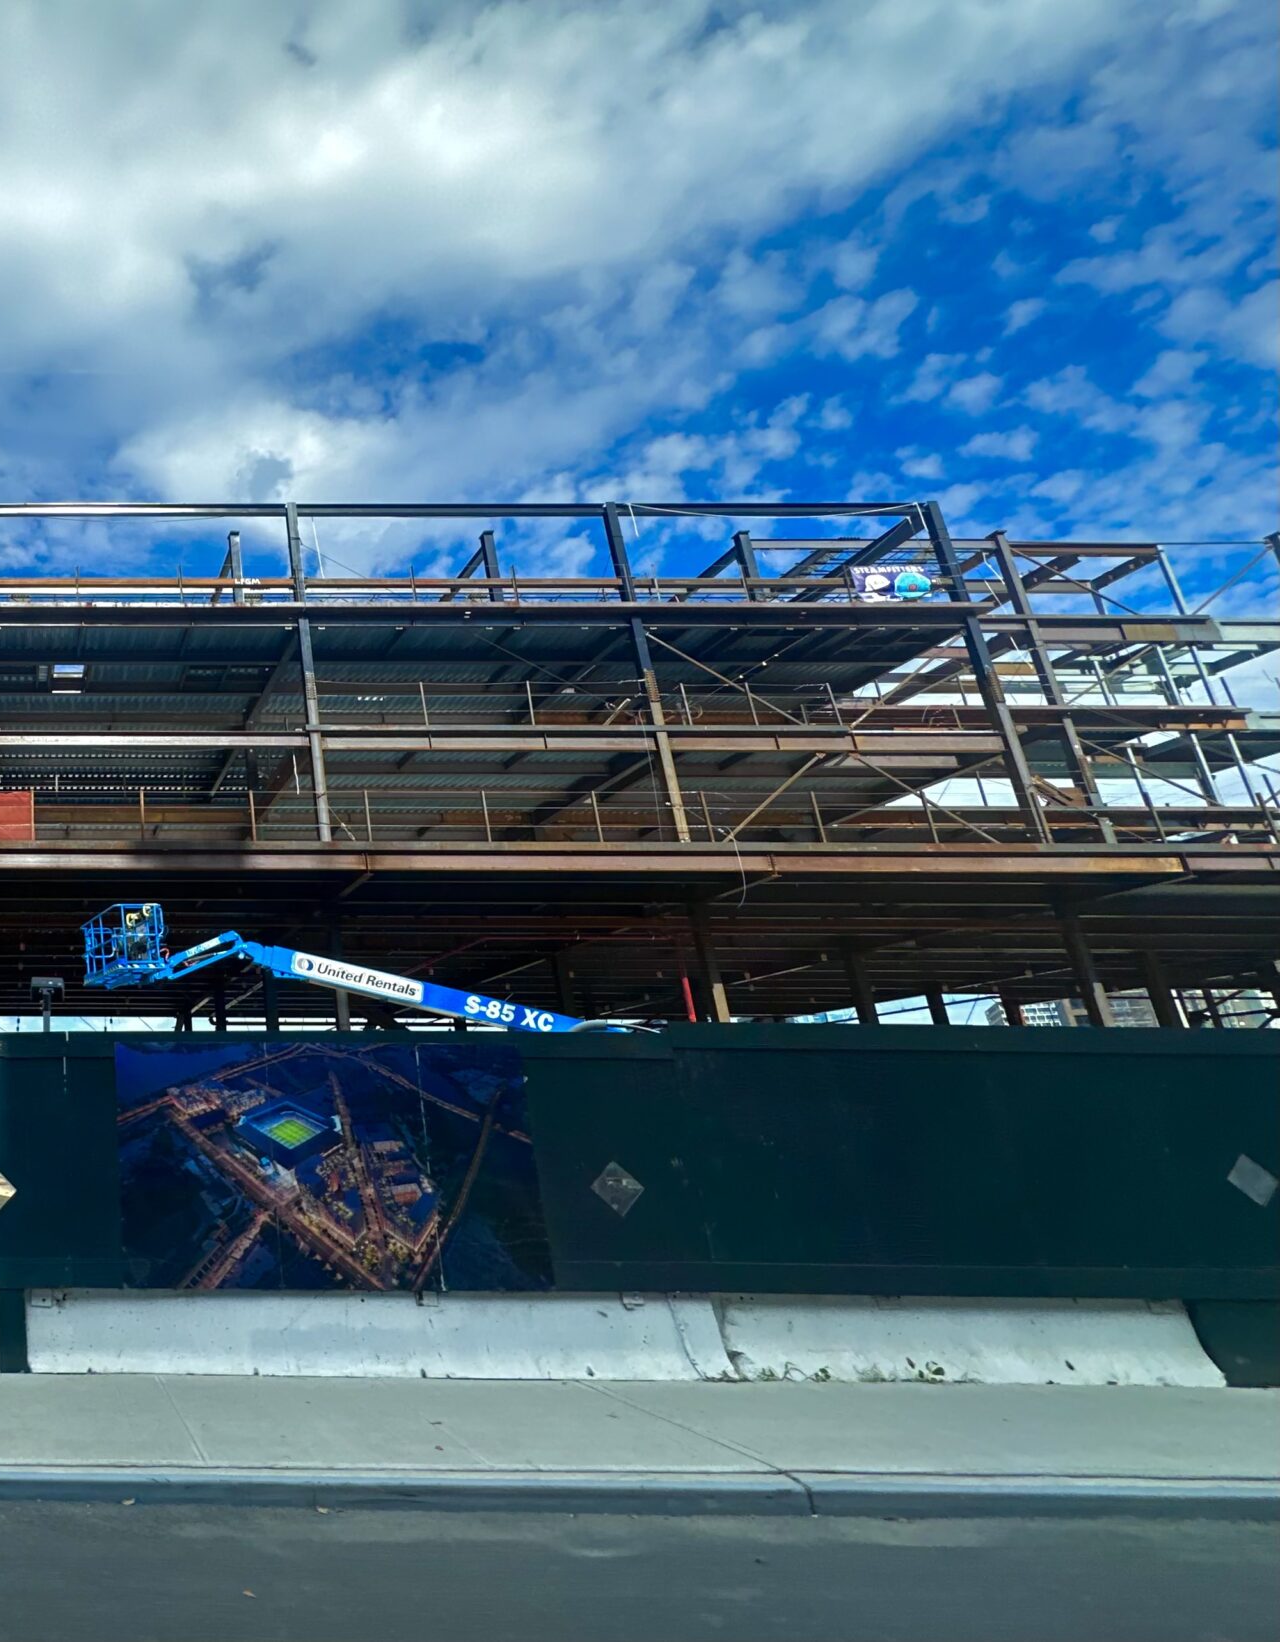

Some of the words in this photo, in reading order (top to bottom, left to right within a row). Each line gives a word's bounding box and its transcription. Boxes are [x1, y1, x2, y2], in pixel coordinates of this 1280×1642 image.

[317, 962, 364, 983] United
[366, 975, 417, 996] Rentals
[464, 995, 516, 1022] S-85
[520, 1008, 554, 1032] XC
